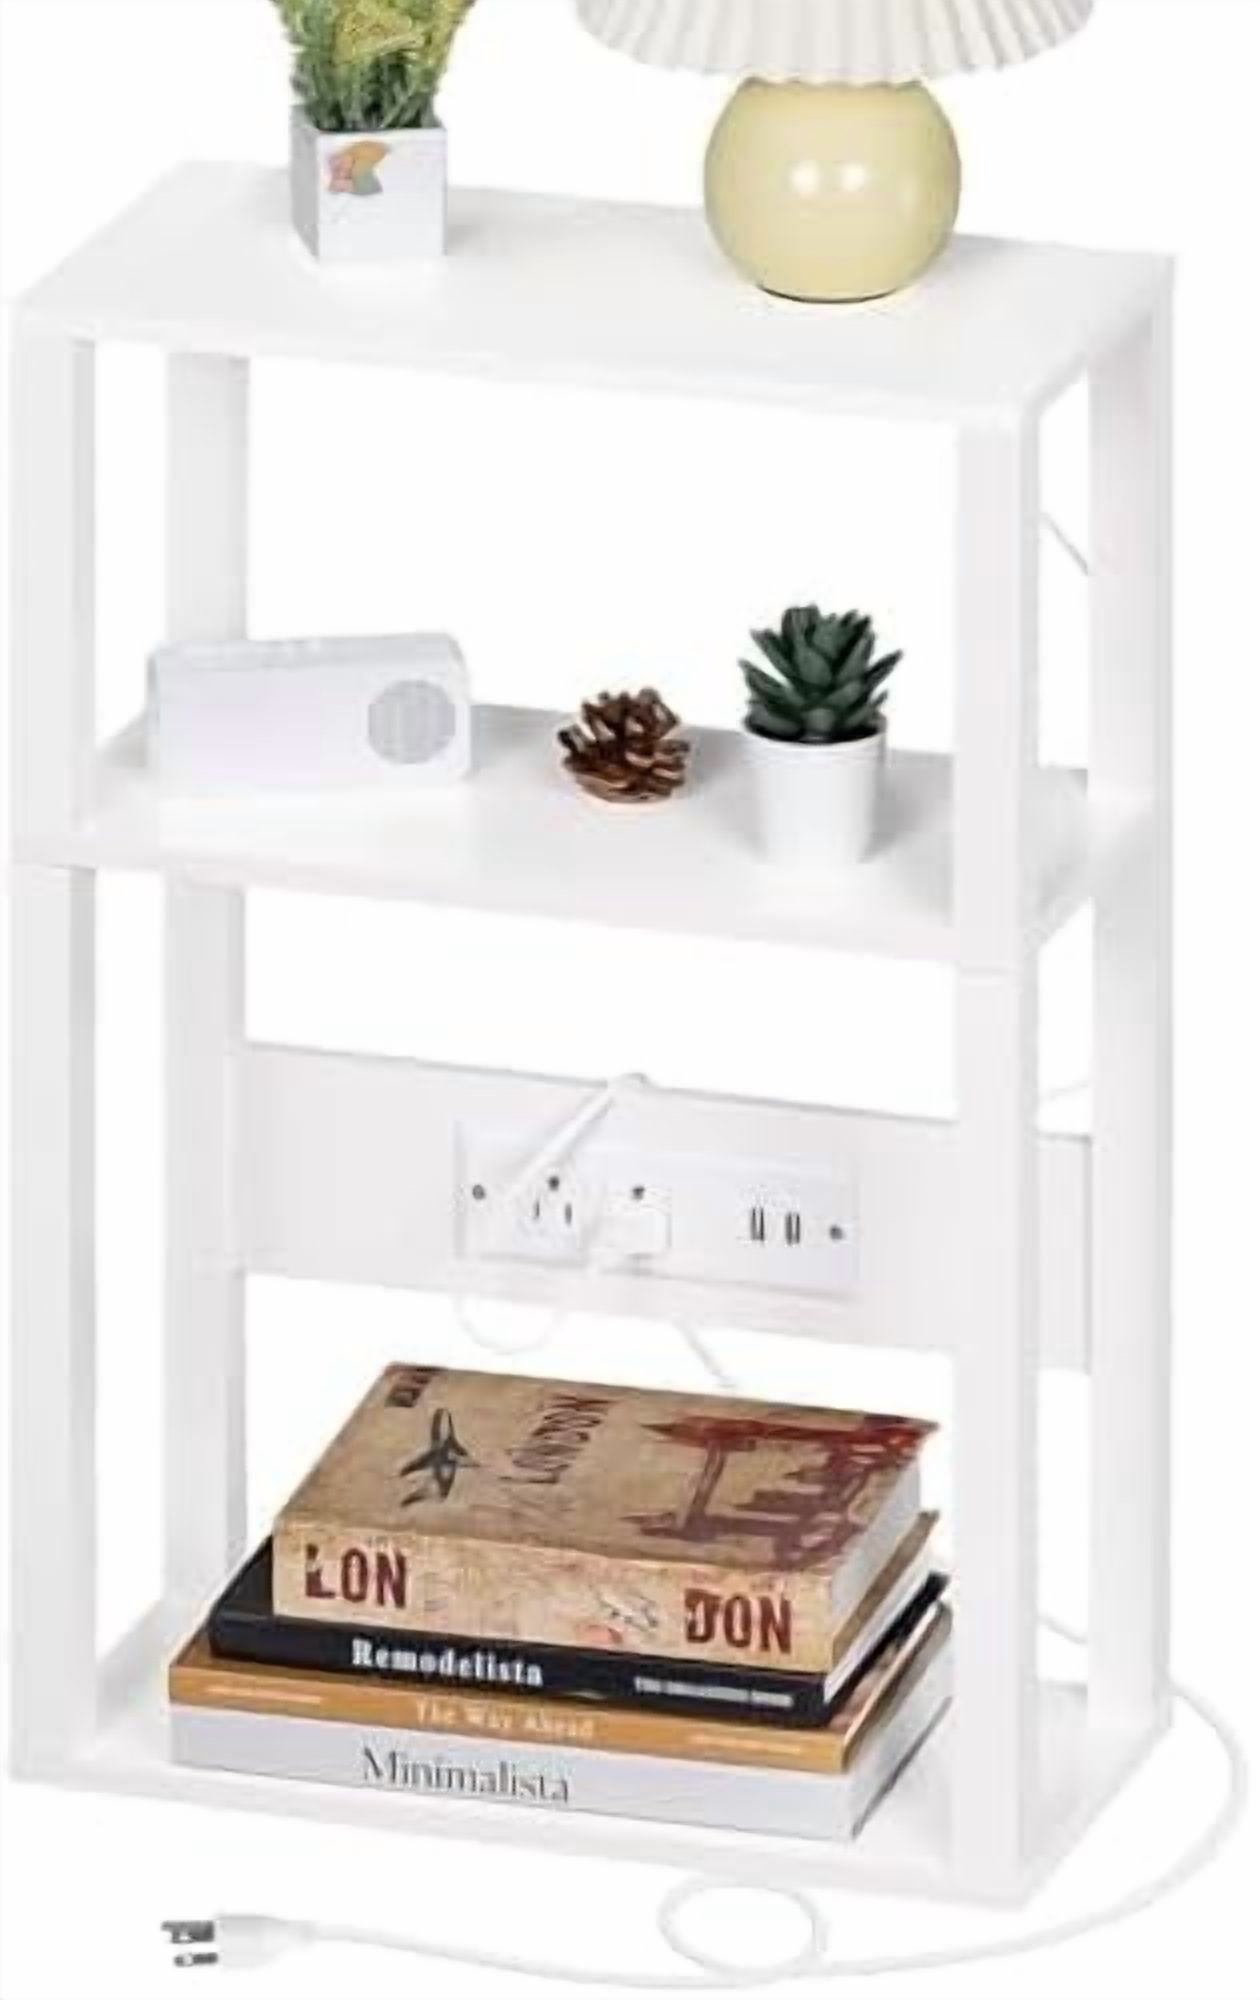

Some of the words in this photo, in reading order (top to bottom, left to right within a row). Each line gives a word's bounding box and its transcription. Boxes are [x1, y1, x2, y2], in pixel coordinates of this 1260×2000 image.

[305, 1543, 407, 1609] LON
[684, 1588, 792, 1655] DON
[351, 1637, 544, 1688] Remodelista
[416, 1698, 457, 1725] The
[363, 1746, 569, 1803] Minimalista
